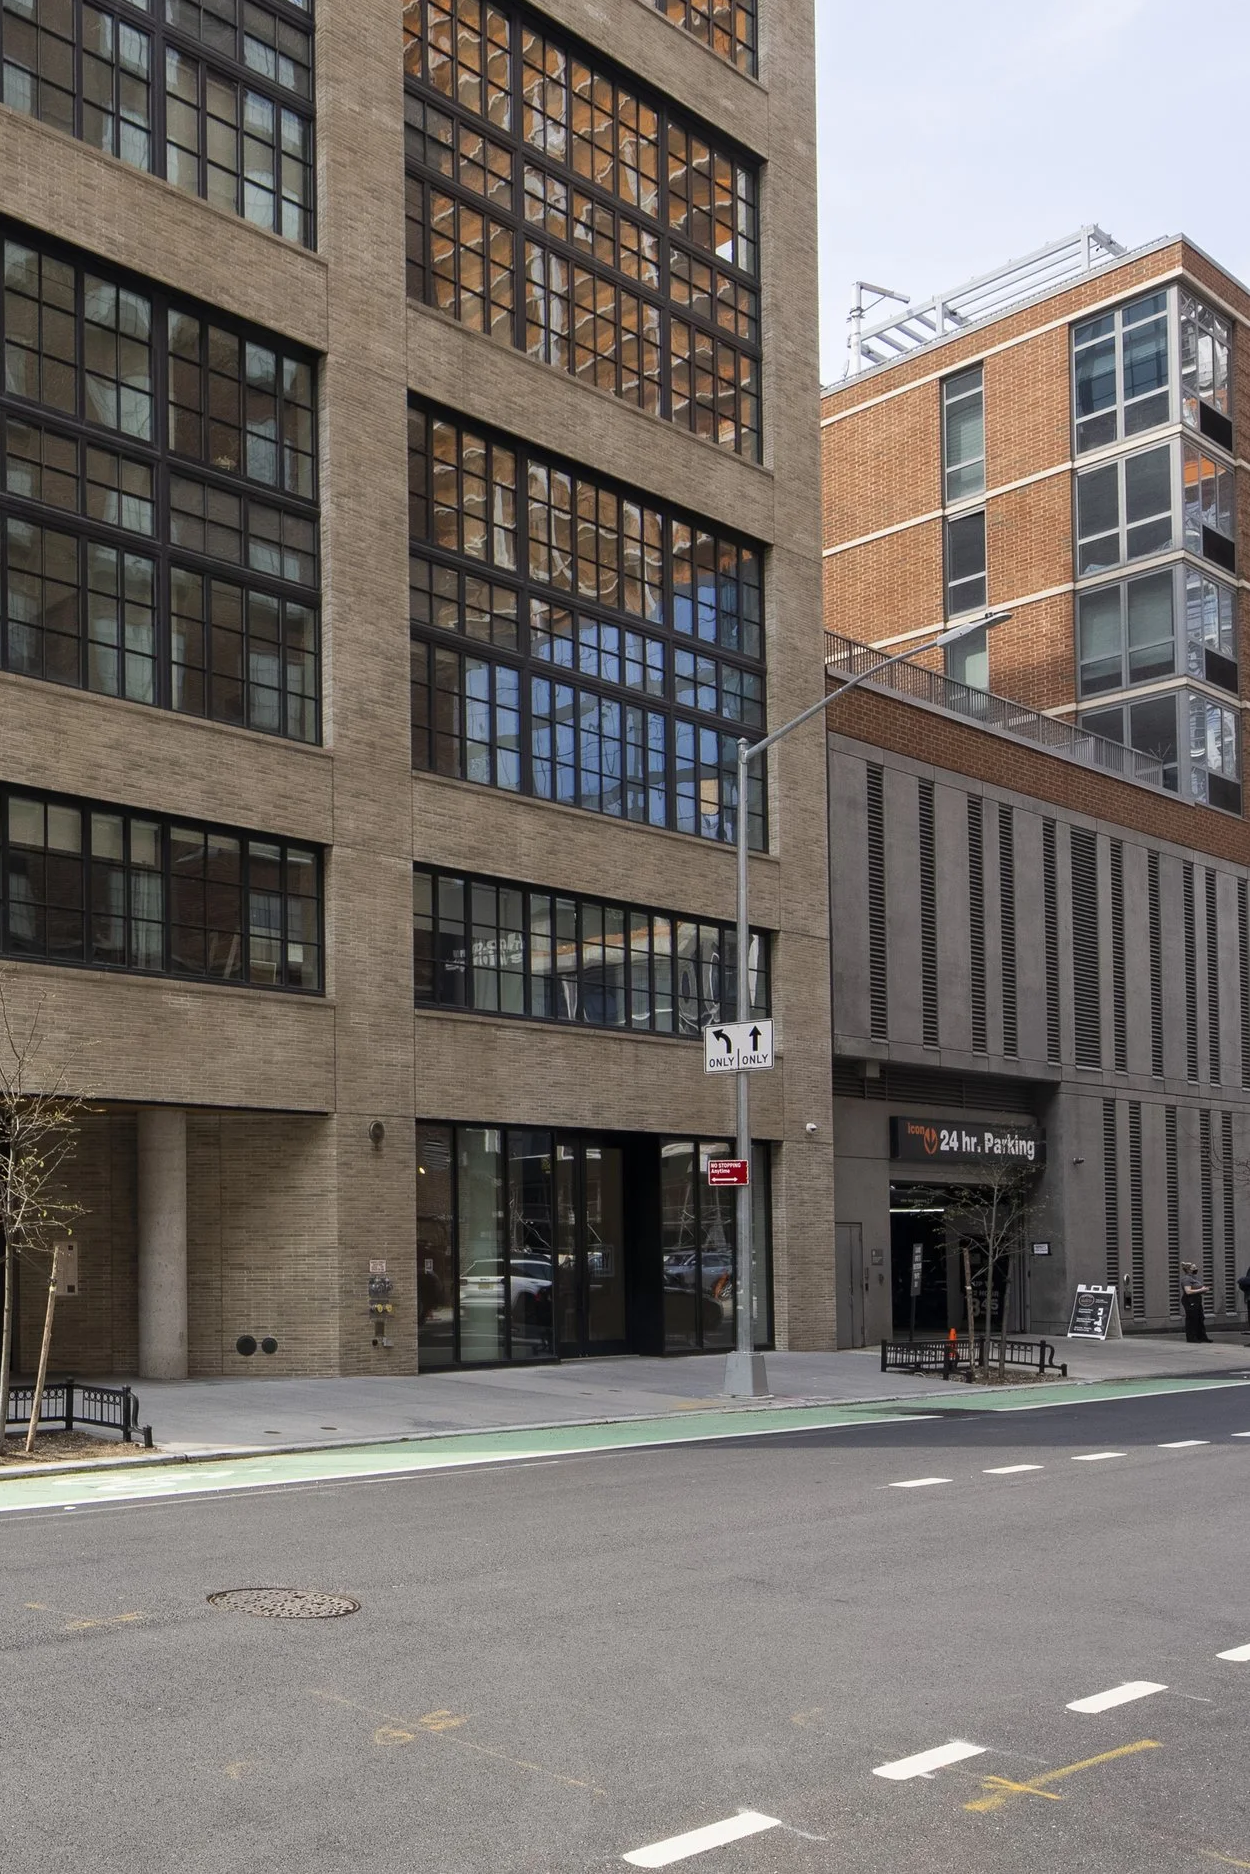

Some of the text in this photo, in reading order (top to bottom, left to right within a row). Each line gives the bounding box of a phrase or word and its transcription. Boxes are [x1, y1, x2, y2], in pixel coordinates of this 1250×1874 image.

[709, 1057, 735, 1068] ONLY
[742, 1053, 768, 1065] ONLY
[940, 1129, 1036, 1160] 24 hr. Parking
